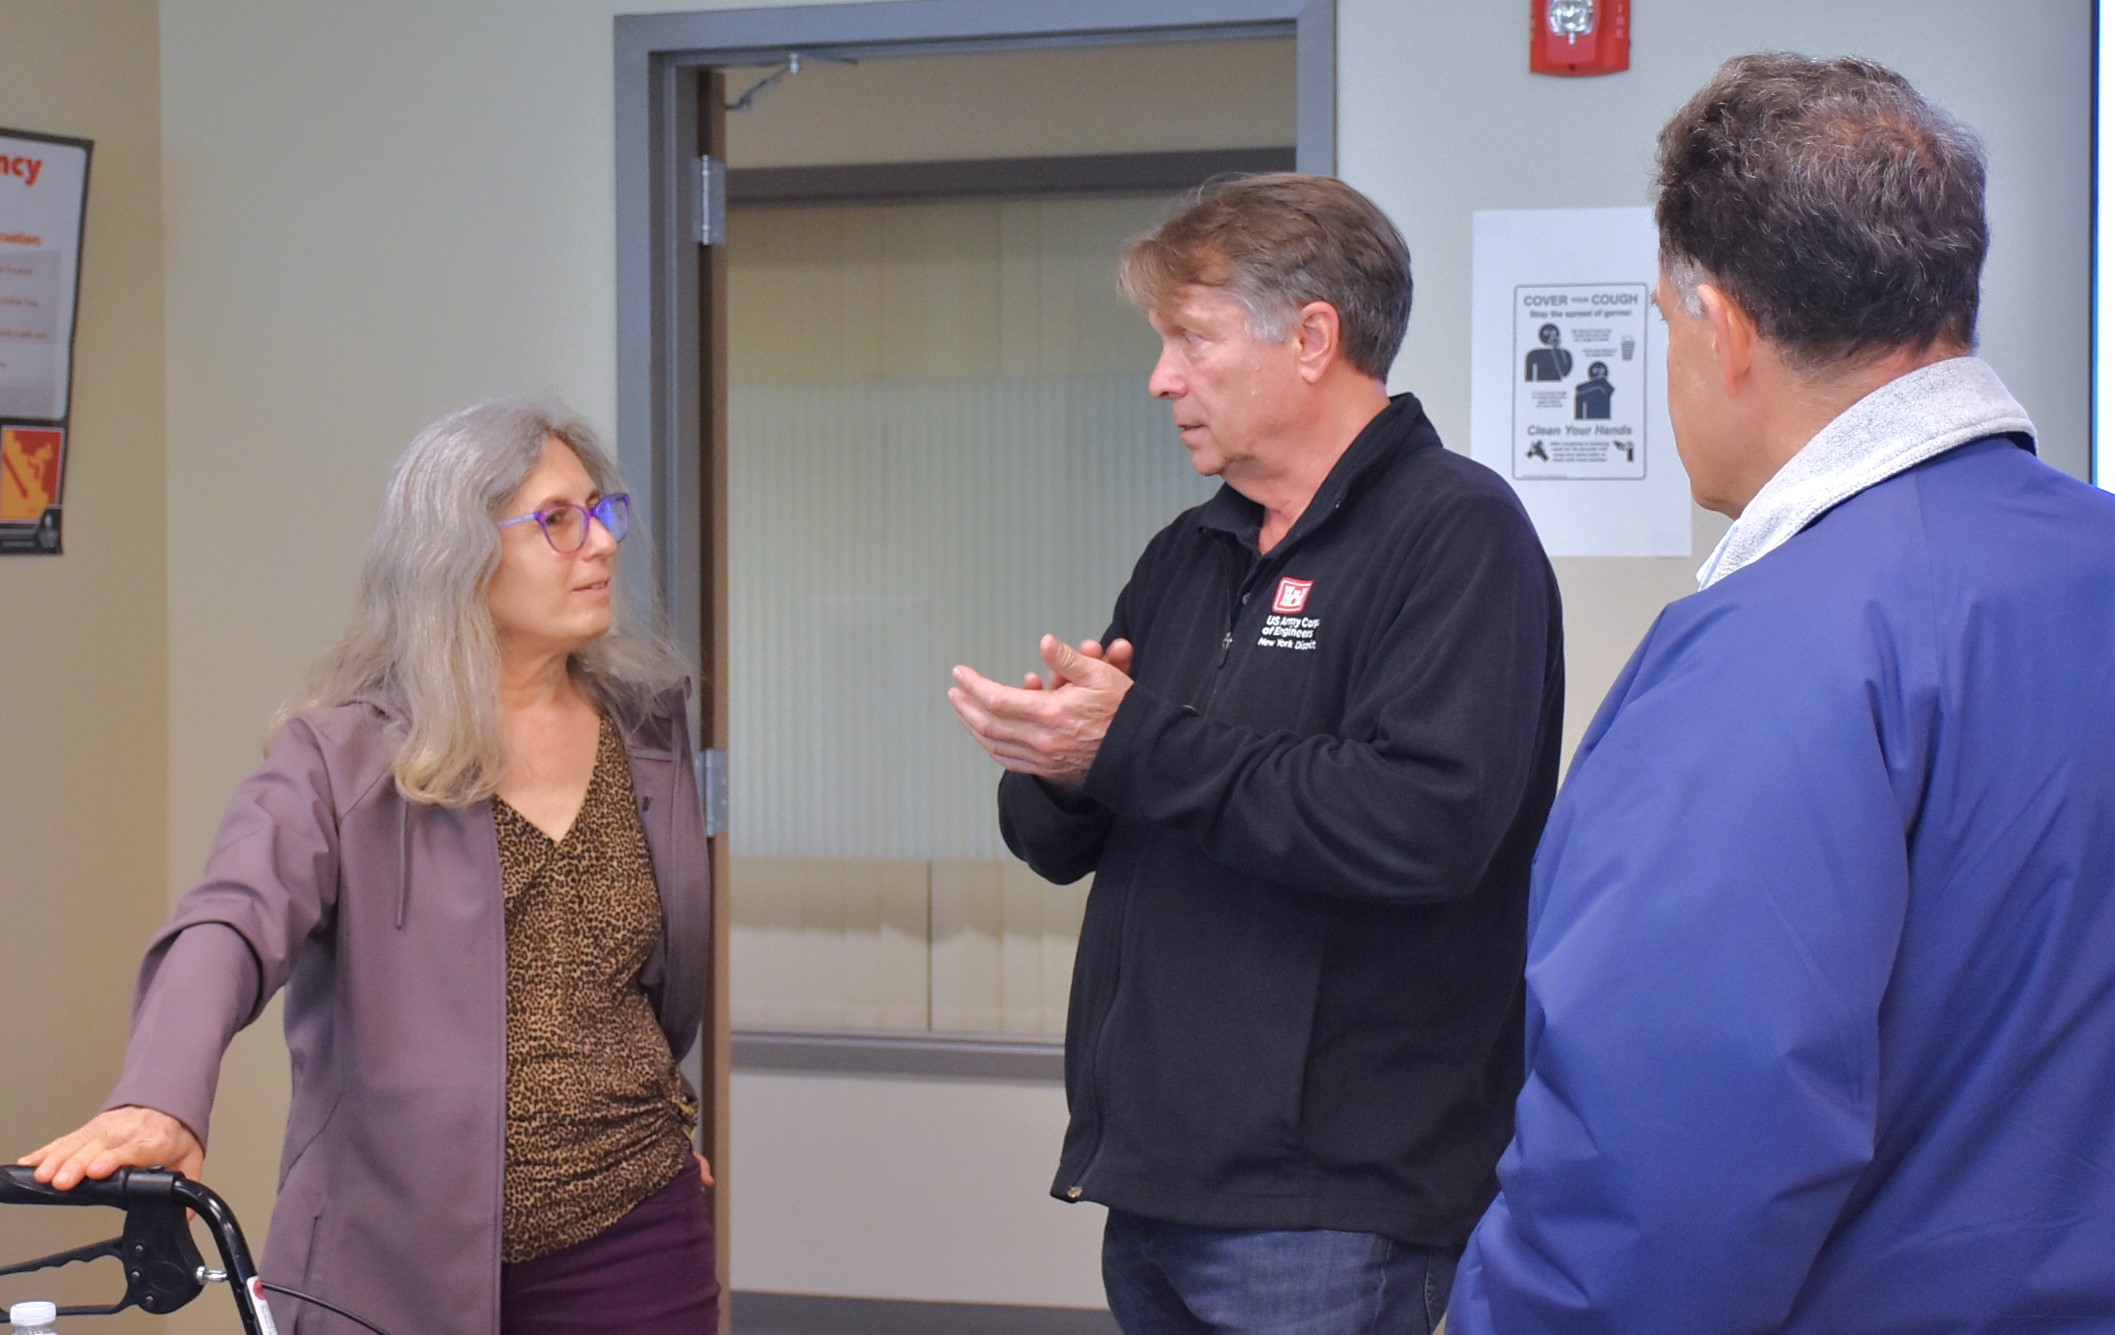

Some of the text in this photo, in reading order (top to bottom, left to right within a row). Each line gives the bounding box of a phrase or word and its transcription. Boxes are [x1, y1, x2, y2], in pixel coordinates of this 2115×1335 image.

[1523, 295, 1568, 307] COVER
[1591, 293, 1638, 305] COUGH
[1530, 311, 1548, 319] Stop
[1565, 310, 1592, 318] spread
[1527, 425, 1632, 436] Clean Your Hands
[1266, 615, 1280, 626] US
[1280, 617, 1301, 628] Army
[1261, 626, 1314, 638] of Engineers
[1257, 637, 1276, 647] New
[1276, 638, 1293, 648] York
